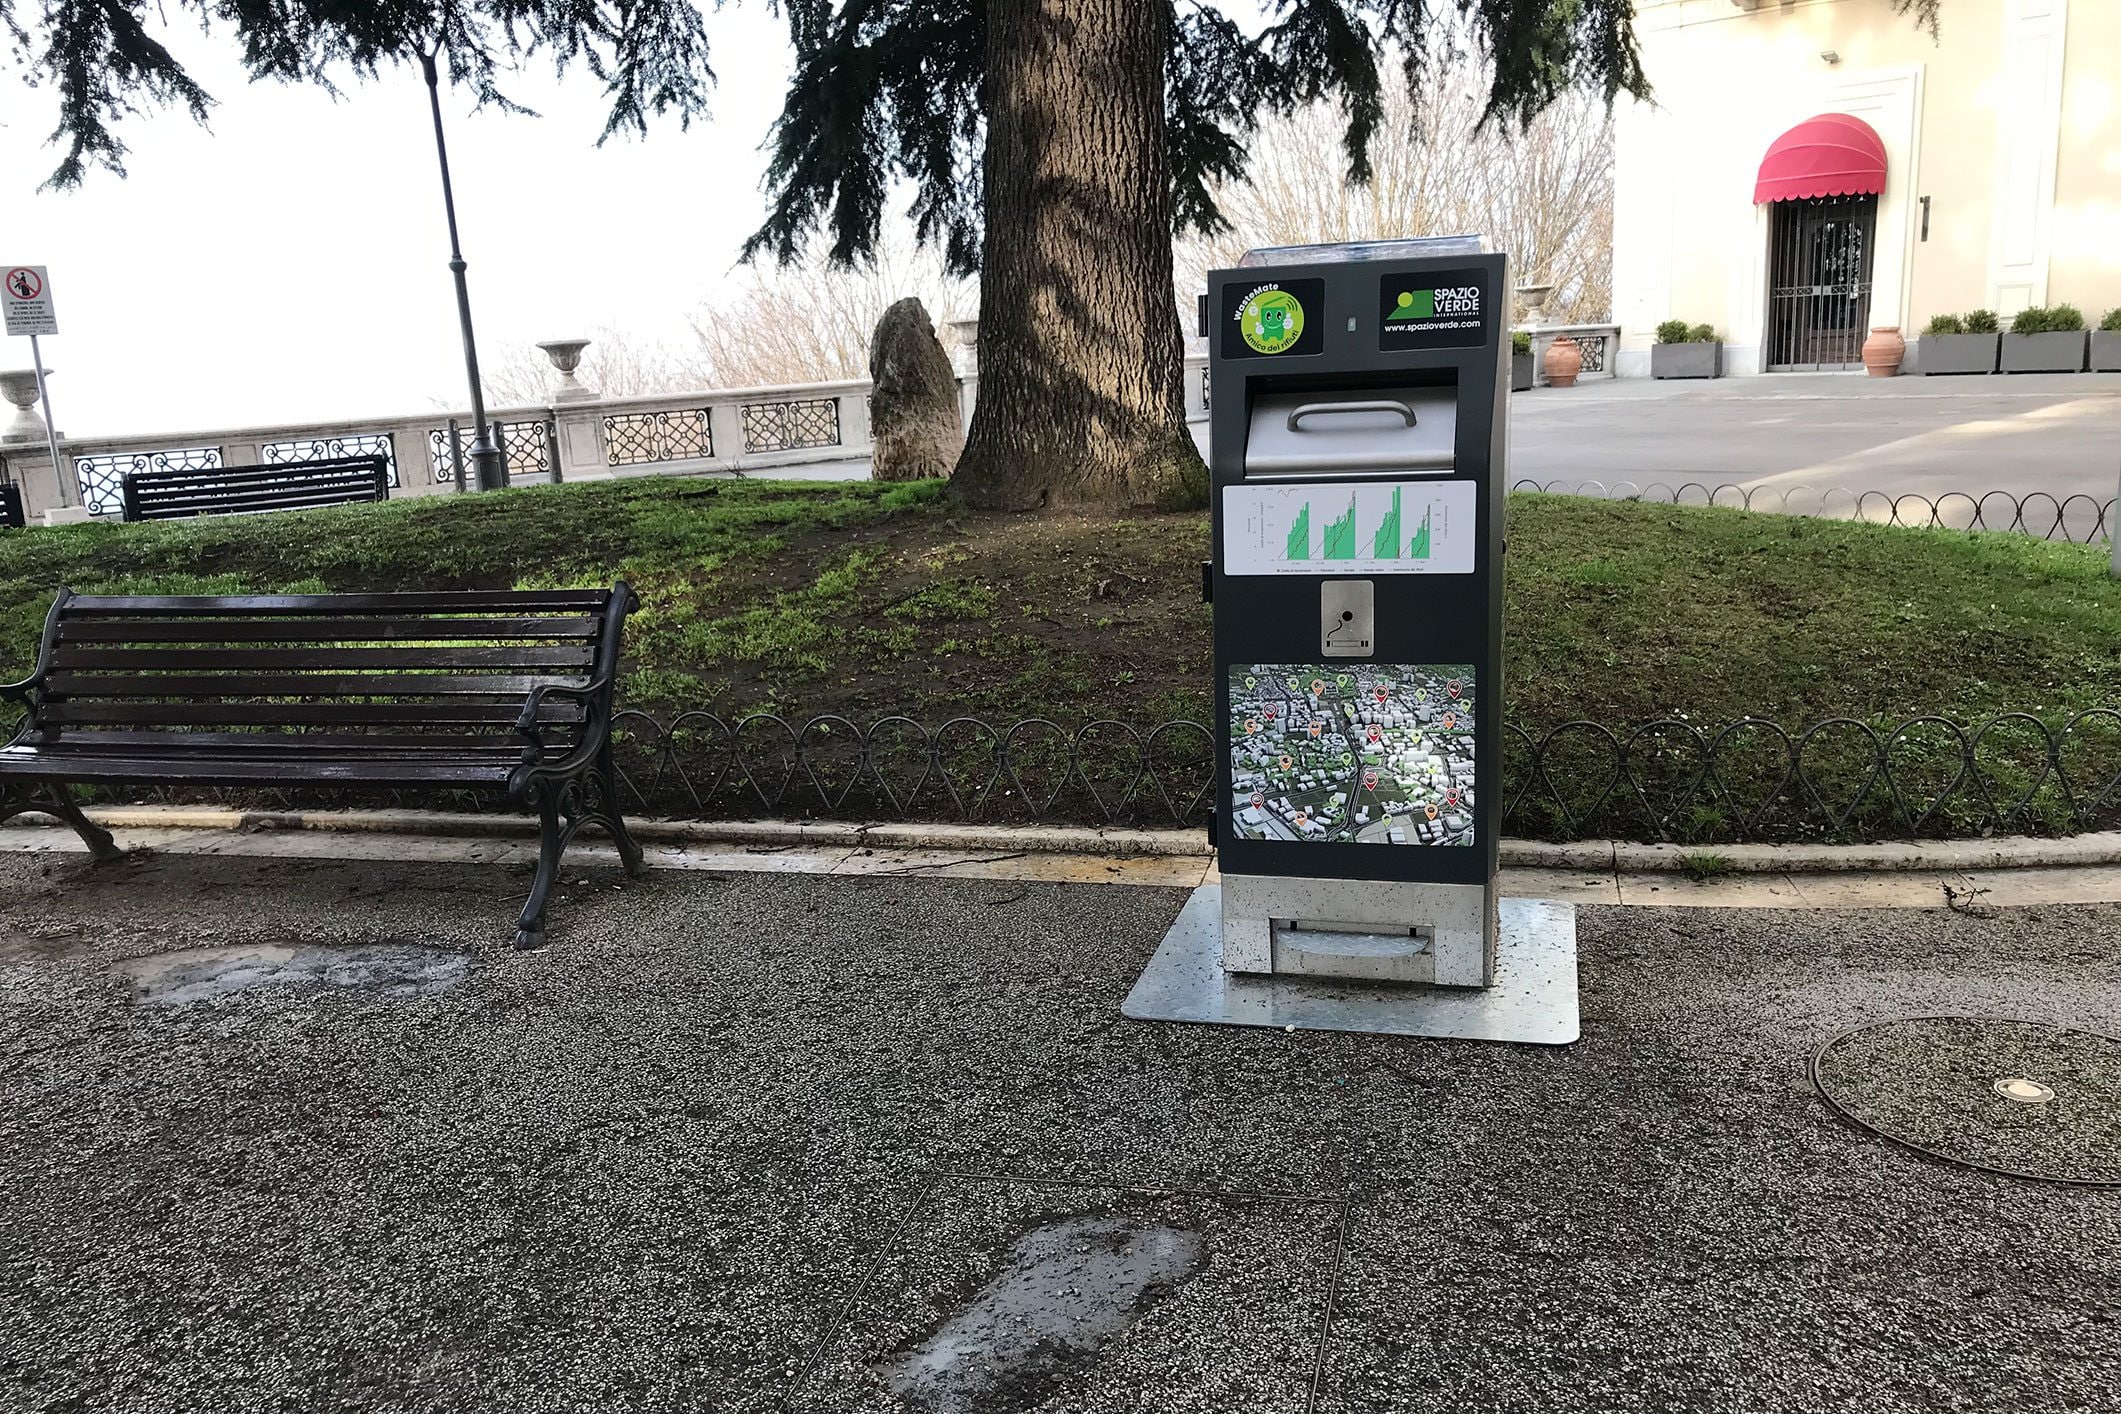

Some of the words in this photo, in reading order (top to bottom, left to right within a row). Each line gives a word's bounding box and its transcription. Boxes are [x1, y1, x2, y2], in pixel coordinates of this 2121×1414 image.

[1434, 286, 1480, 301] SPAZIO
[1233, 283, 1279, 321] WasteMate
[1434, 299, 1480, 312] VERDE
[1384, 320, 1481, 332] www.spazioverde.com
[1246, 333, 1266, 351] Amico
[1281, 330, 1299, 349] rifiuti
